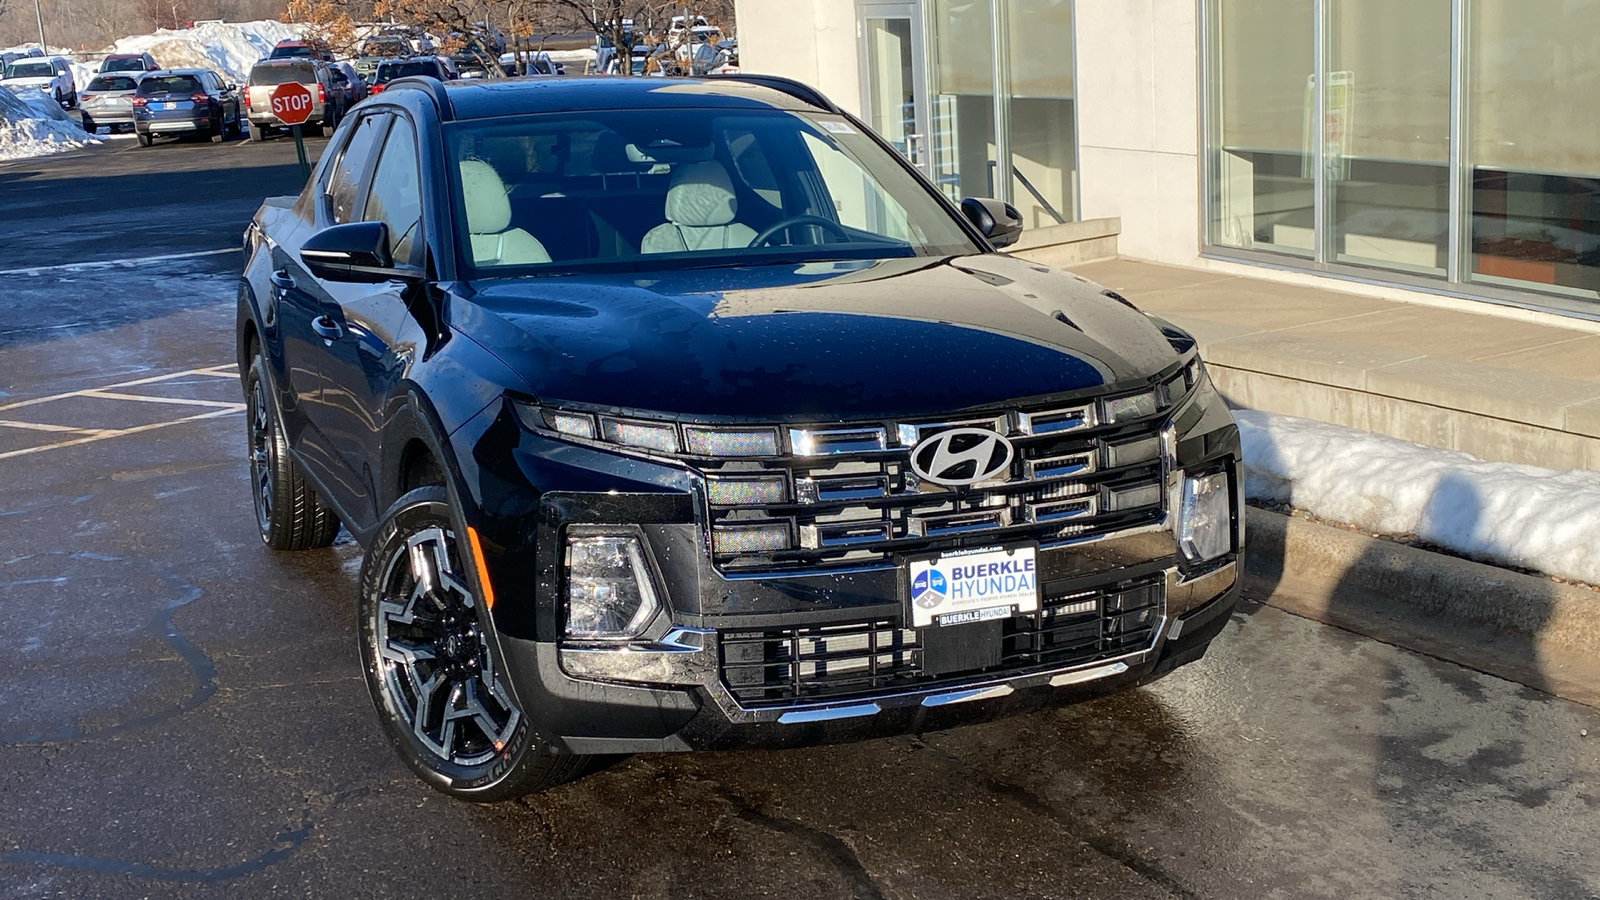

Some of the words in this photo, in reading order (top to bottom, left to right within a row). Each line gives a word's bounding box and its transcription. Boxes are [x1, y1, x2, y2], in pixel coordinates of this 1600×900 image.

[273, 93, 310, 113] STOP
[952, 558, 1034, 581] BUERKLE
[952, 573, 1035, 600] HYUNDAI
[941, 611, 980, 624] BUERKLE
[980, 607, 1009, 619] HYUNDAI
[495, 717, 529, 777] ICHELIN
